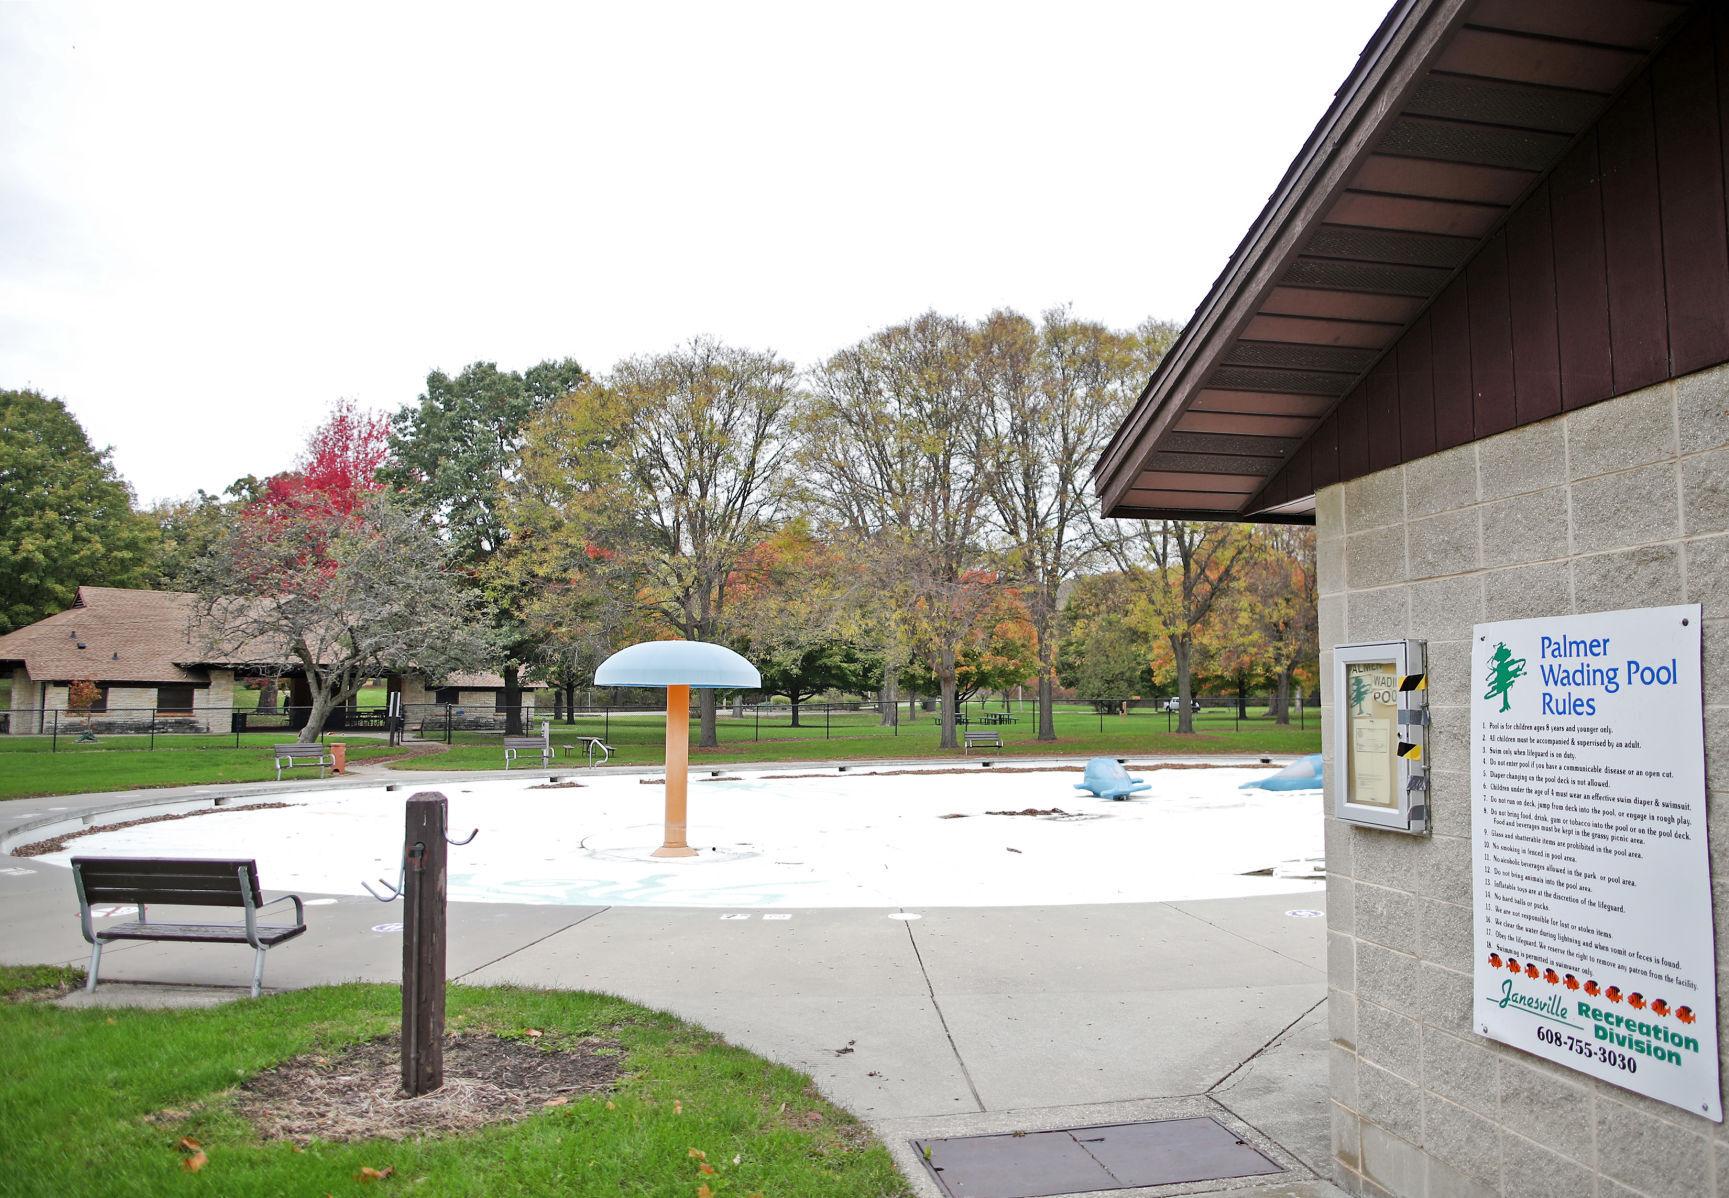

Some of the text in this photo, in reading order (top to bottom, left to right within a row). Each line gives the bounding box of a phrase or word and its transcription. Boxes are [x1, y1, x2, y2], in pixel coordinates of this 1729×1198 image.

[1541, 634, 1610, 659] Palmer
[1373, 674, 1396, 688] WADI
[1540, 659, 1677, 693] Wading Pool
[1373, 690, 1397, 704] POO
[1541, 692, 1596, 716] Rules
[1499, 979, 1568, 1019] Janesville
[1577, 1001, 1699, 1053] Recreation
[1537, 1026, 1637, 1074] 608-755-3030
[1594, 1023, 1682, 1066] Division
